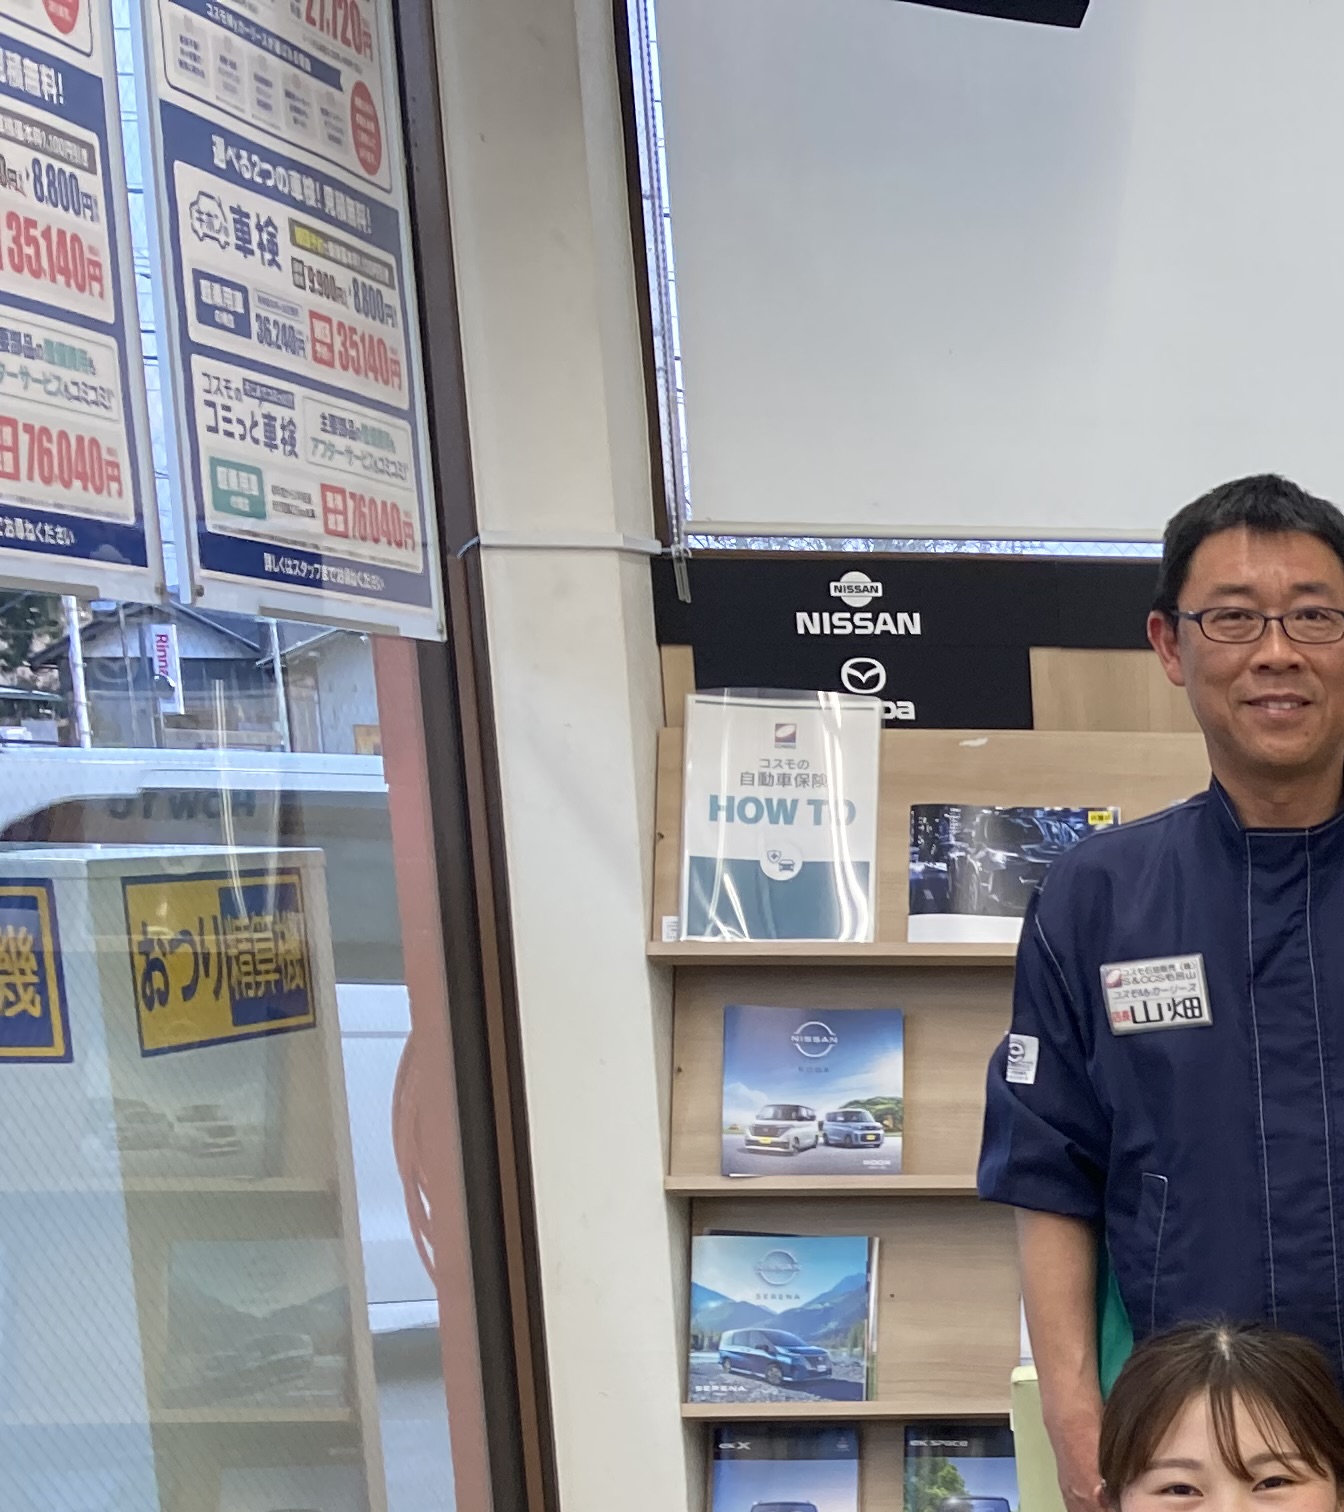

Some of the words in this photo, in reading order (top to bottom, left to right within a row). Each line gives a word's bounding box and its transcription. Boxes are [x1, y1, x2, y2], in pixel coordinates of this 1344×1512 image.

[833, 584, 879, 594] NISSAN
[795, 611, 922, 636] NISSAN
[759, 757, 810, 771] コスモの
[739, 771, 828, 789] 自動車保険
[708, 794, 800, 826] HOW
[1129, 996, 1203, 1024] 山畑
[791, 1034, 839, 1044] NISSAN
[694, 1385, 748, 1393] SERENA
